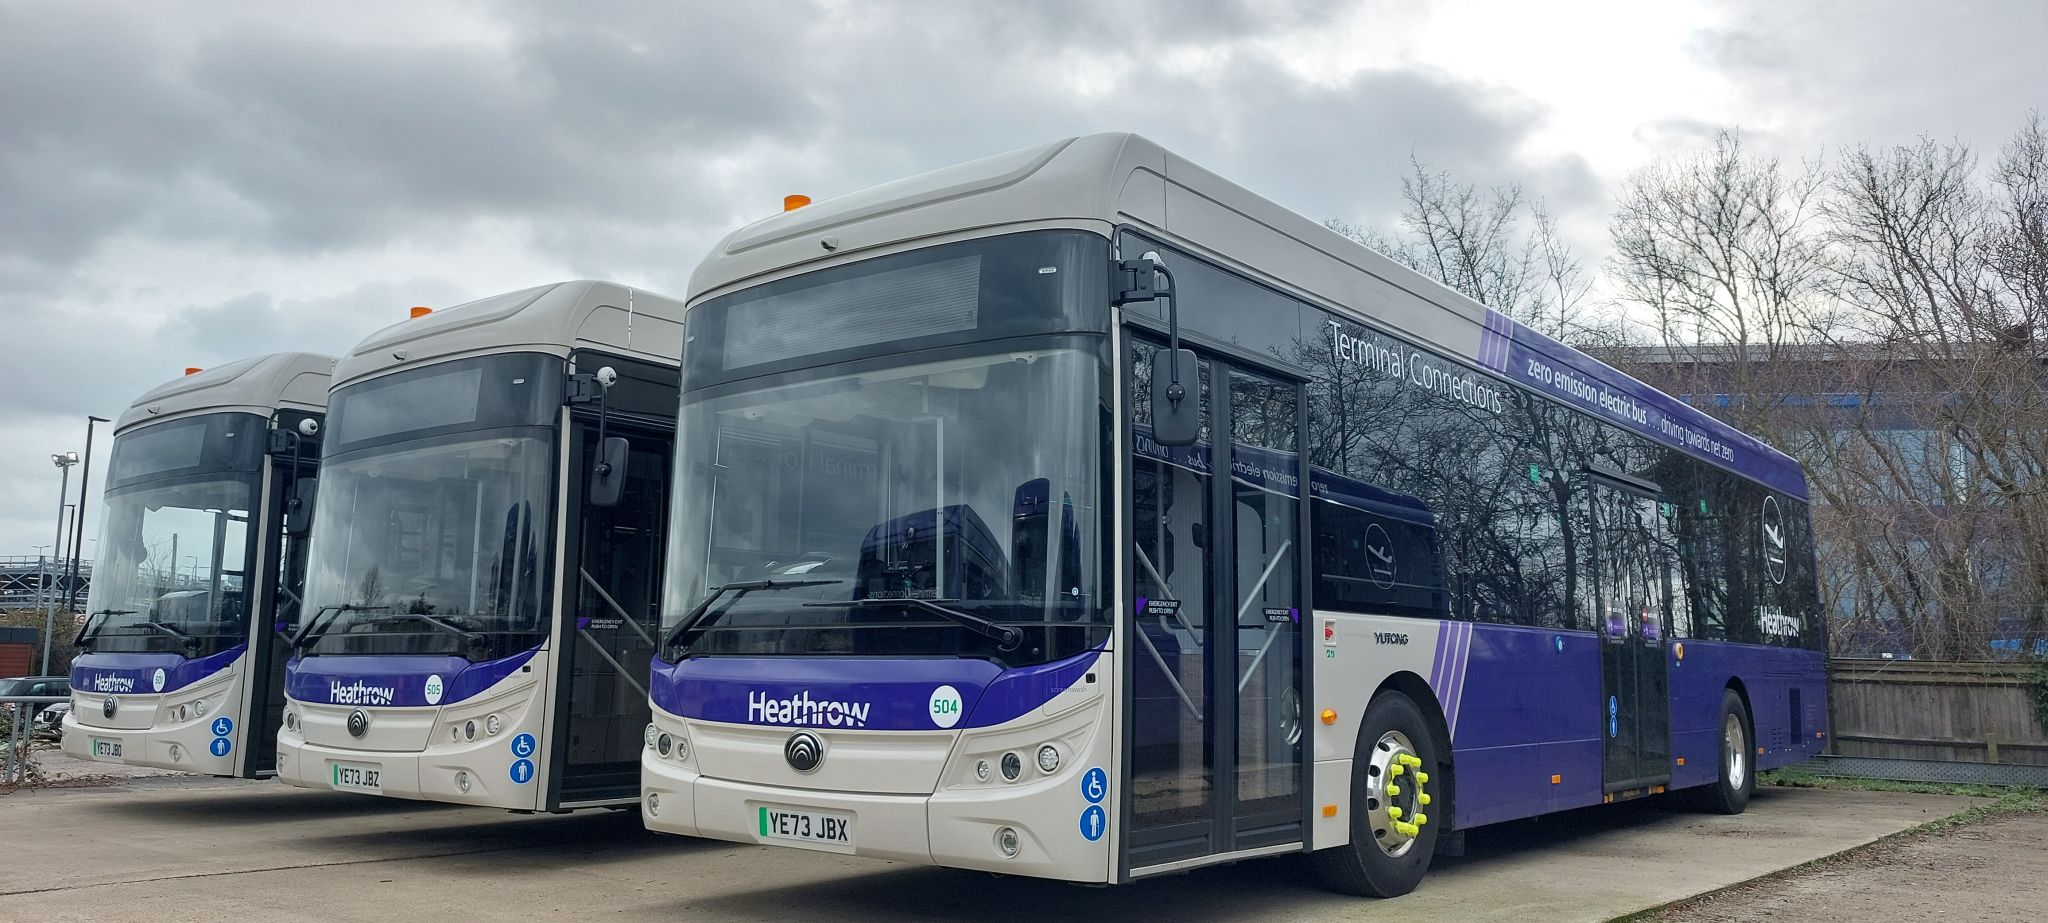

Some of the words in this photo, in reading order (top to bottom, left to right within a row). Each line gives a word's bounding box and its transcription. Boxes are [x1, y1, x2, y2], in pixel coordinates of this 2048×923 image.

[1329, 320, 1405, 380] Terminal
[1410, 353, 1502, 414] Connections
[1527, 359, 1552, 384] zero
[1554, 371, 1597, 405] emission
[1599, 386, 1631, 418] electric
[1632, 399, 1647, 425] bus
[1661, 414, 1684, 446] driving
[1685, 426, 1710, 453] towards
[1710, 440, 1721, 457] net
[1721, 445, 1734, 462] zero
[1760, 605, 1799, 637] Heathrow
[1374, 632, 1408, 645] YUTONG
[94, 672, 134, 693] Heathrow
[330, 679, 394, 705] Heathrow
[426, 684, 441, 695] 505
[748, 690, 871, 727] Heathrow
[933, 699, 958, 714] 504
[97, 742, 111, 755] YE73
[339, 768, 360, 786] YE73
[362, 770, 379, 787] JBZ
[769, 812, 811, 837] YE73
[816, 817, 848, 842] JBX
